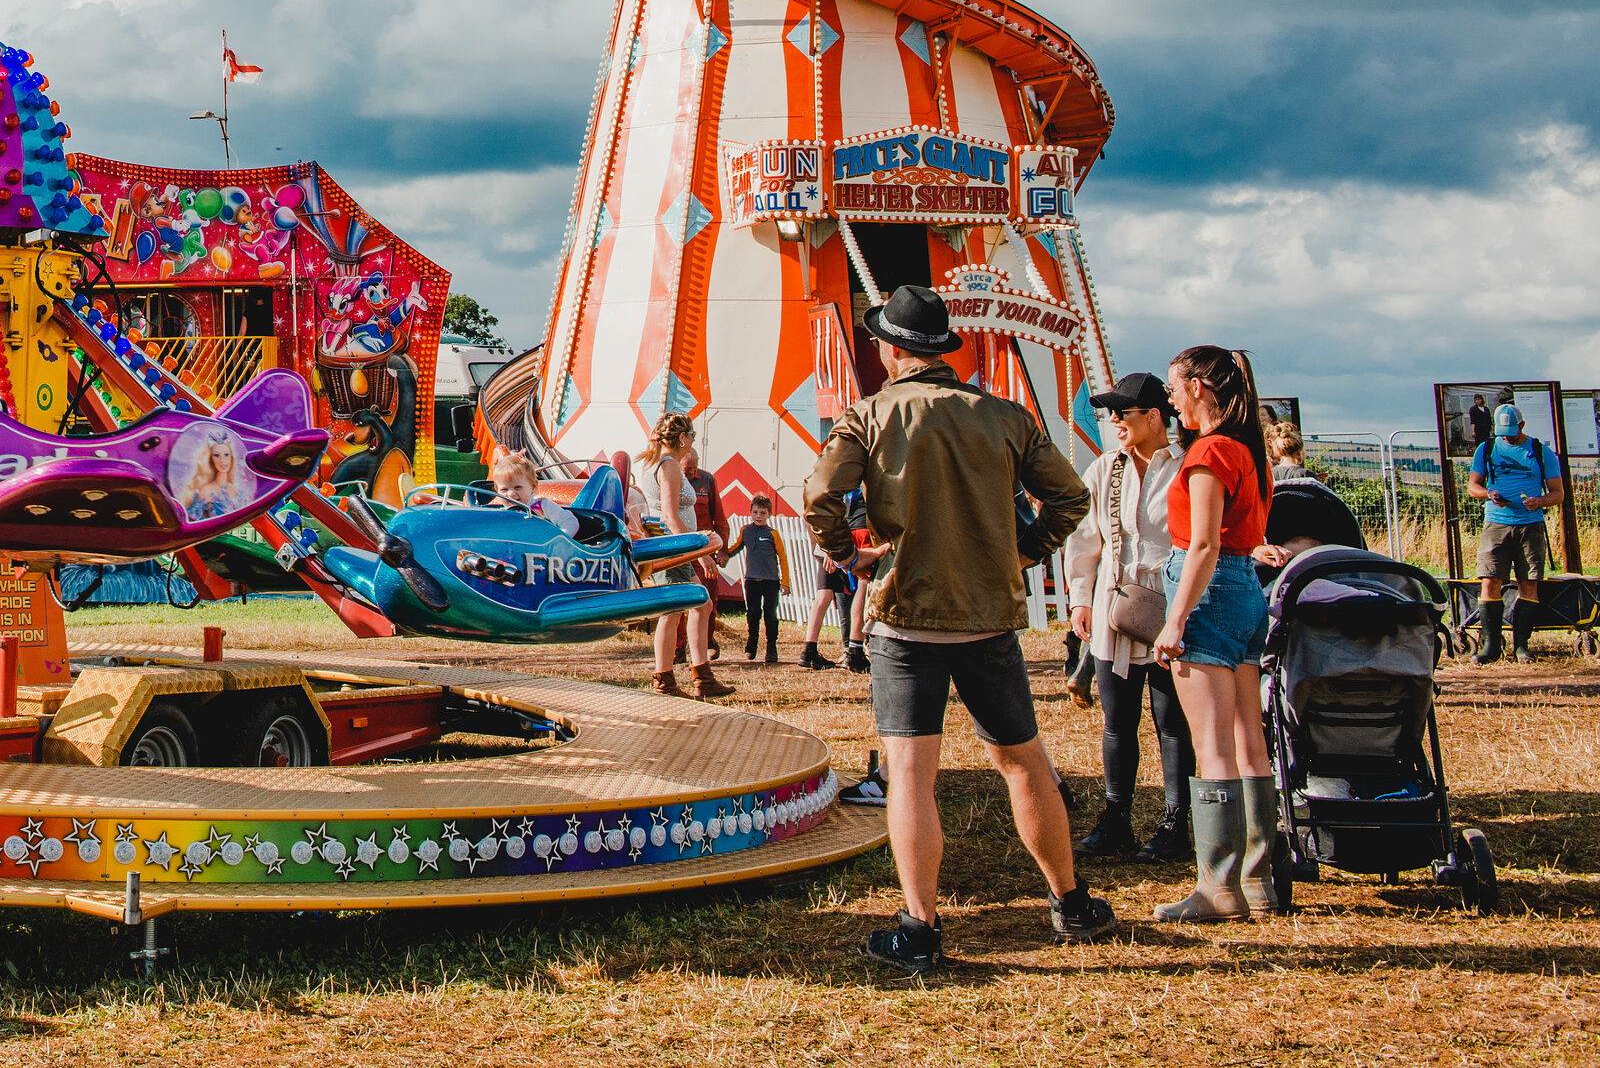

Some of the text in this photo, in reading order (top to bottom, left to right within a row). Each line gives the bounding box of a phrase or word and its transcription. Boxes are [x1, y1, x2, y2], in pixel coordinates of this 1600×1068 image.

[922, 136, 1009, 185] GIANT
[760, 179, 796, 192] FOR
[834, 183, 1010, 214] HELTER SKELTER
[963, 273, 992, 282] circa
[967, 283, 988, 291] 1952
[946, 298, 1080, 338] ORGET YOUR MAT
[523, 552, 622, 587] FROZEN
[0, 596, 32, 609] RIDE
[0, 612, 32, 626] IS IN
